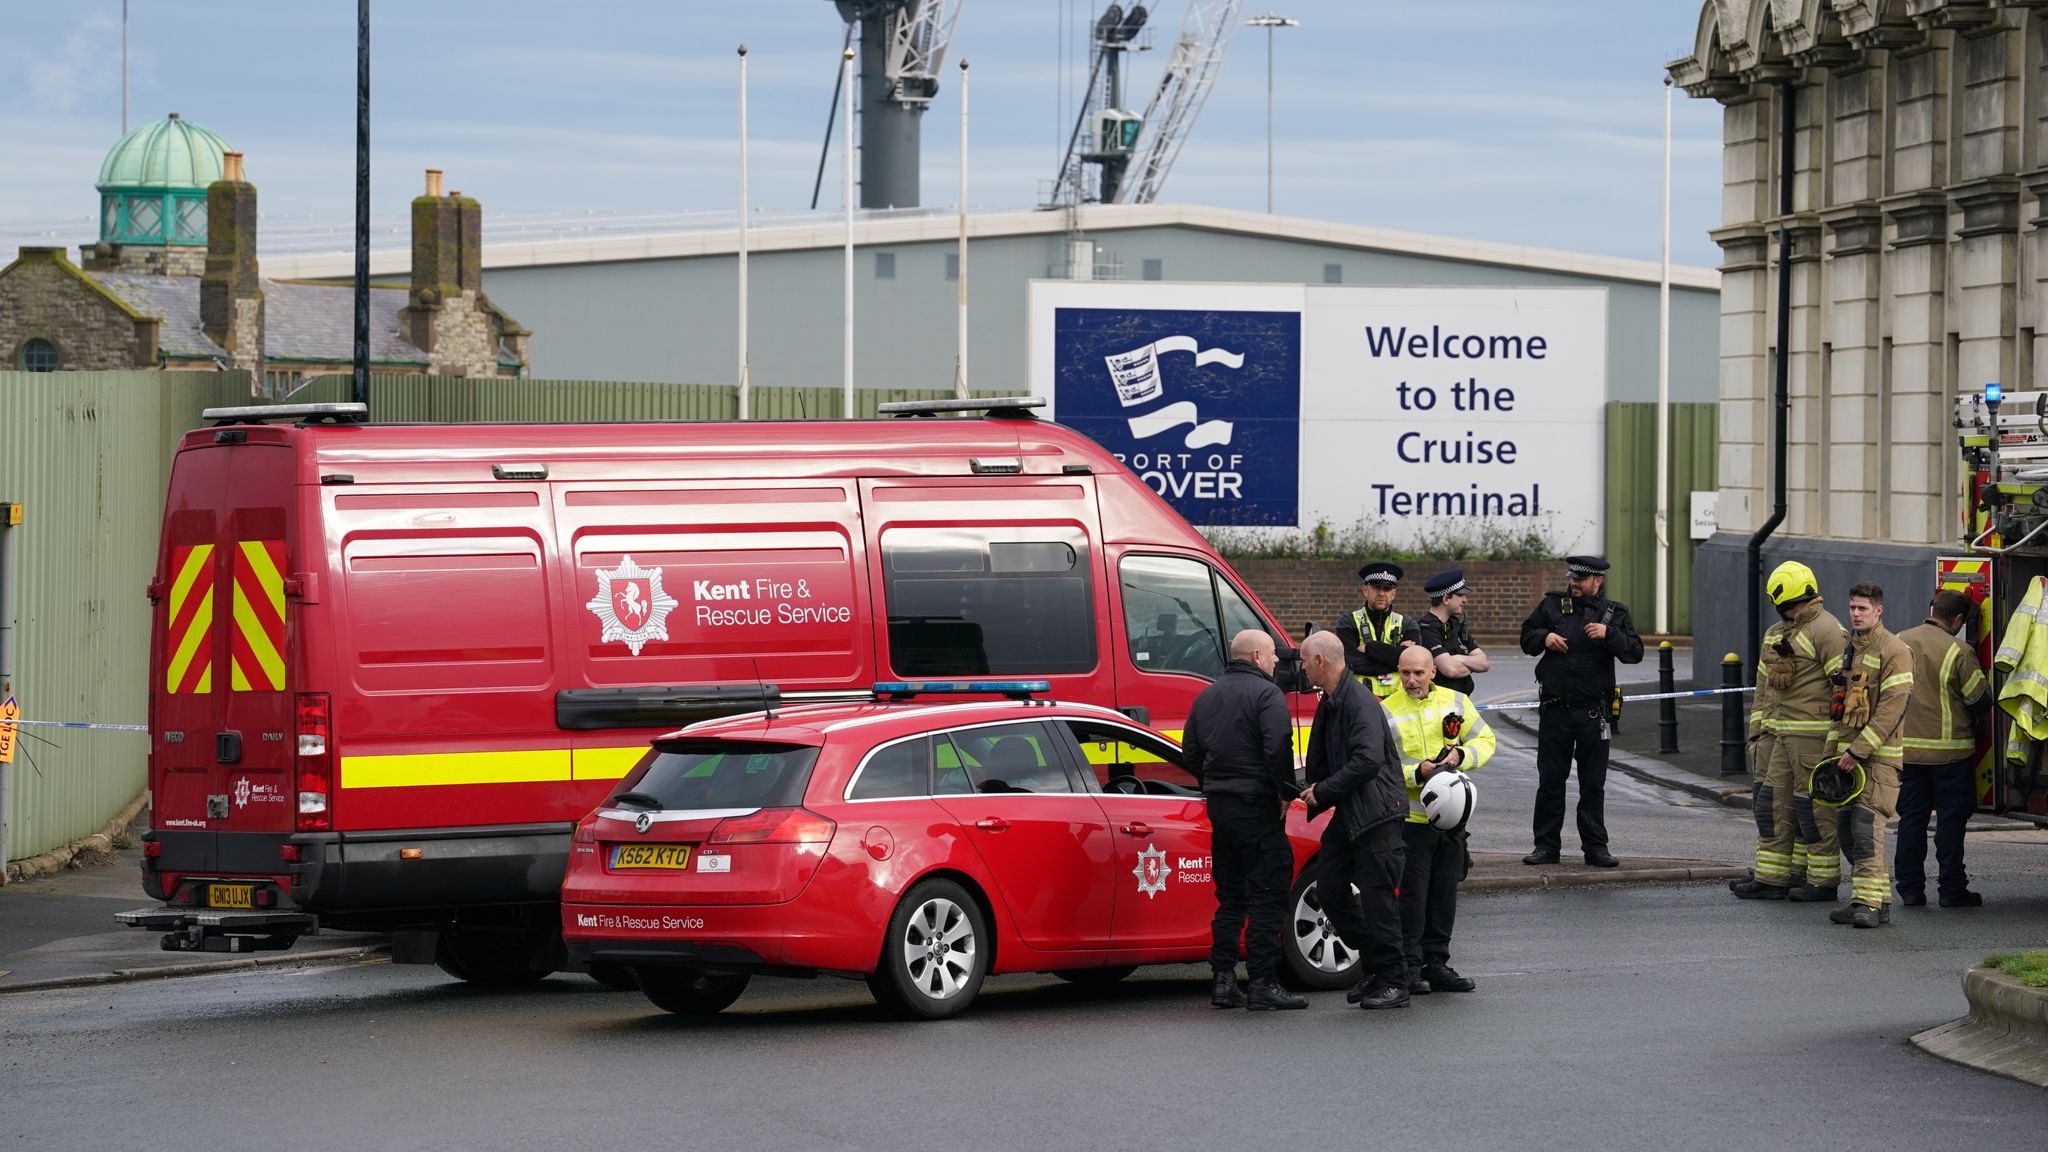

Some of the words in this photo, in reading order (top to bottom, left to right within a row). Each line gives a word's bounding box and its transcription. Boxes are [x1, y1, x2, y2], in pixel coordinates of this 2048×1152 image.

[1365, 325, 1547, 359] Welcome
[1396, 381, 1437, 411] to
[1451, 378, 1515, 411] the
[1397, 431, 1517, 464] Cruise
[1207, 454, 1243, 470] OF
[1140, 471, 1243, 499] OVER
[1371, 483, 1539, 516] Terminal
[693, 579, 751, 600] Kent
[756, 579, 793, 599] Fire
[797, 579, 812, 598] &
[696, 605, 772, 627] Rescue
[777, 603, 851, 624] Service
[262, 732, 284, 741] DAILY
[252, 785, 265, 793] Kent
[265, 785, 274, 793] Fire
[617, 846, 652, 865] KS62
[655, 847, 687, 865] KTO
[1178, 857, 1203, 869] Kent
[1178, 871, 1211, 883] Rescue
[213, 887, 231, 905] GN13
[232, 887, 250, 905] UJX
[577, 914, 598, 927] Kent
[598, 914, 614, 928] Fire
[615, 916, 622, 927] &
[622, 916, 660, 929] Rescue
[662, 915, 704, 929] Service
